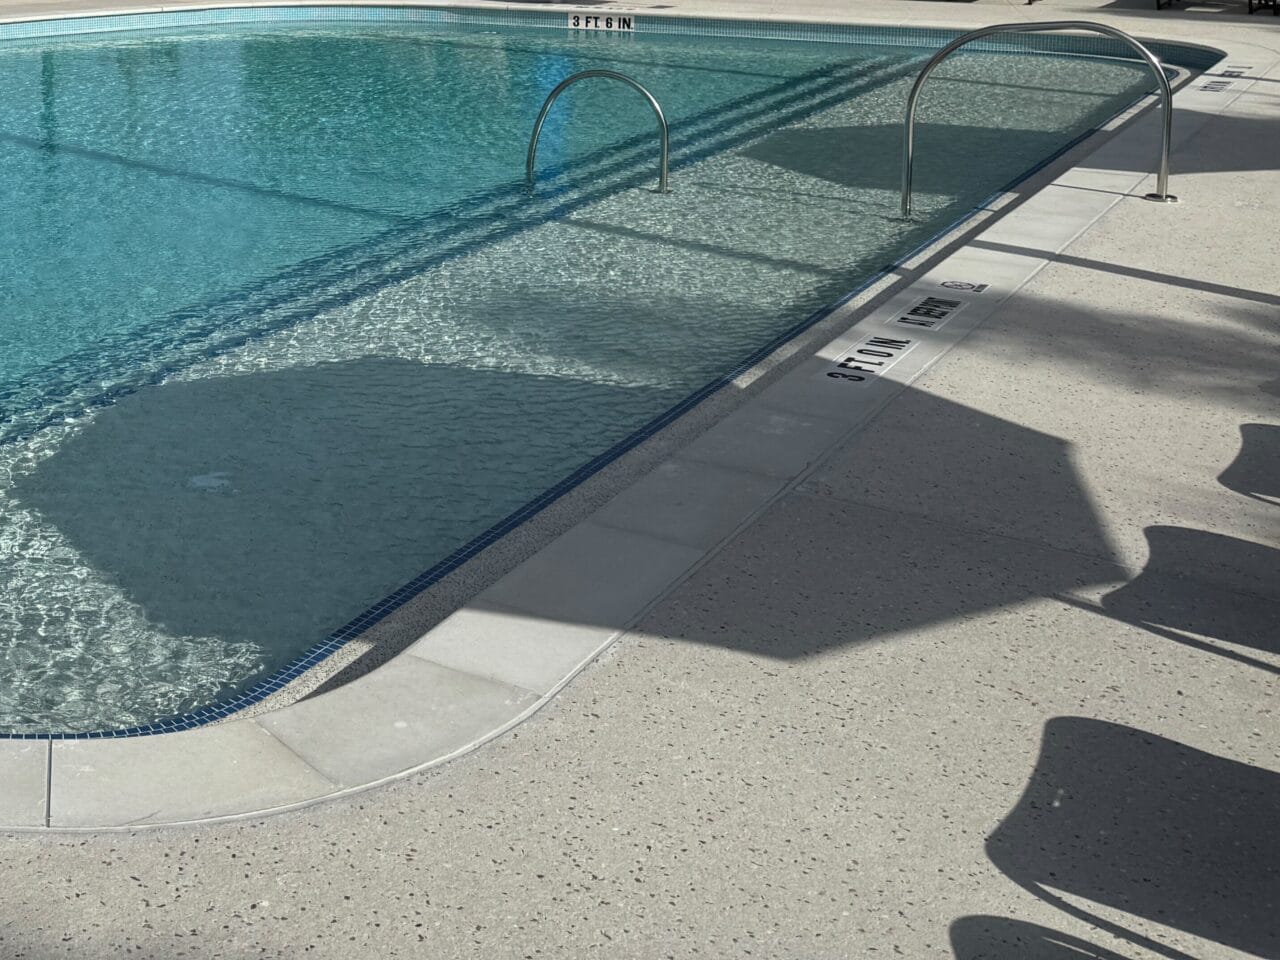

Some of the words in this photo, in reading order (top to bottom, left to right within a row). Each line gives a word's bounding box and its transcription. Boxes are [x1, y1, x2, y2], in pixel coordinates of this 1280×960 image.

[573, 15, 580, 27] 3
[606, 17, 613, 29] 6
[826, 372, 866, 382] 3
